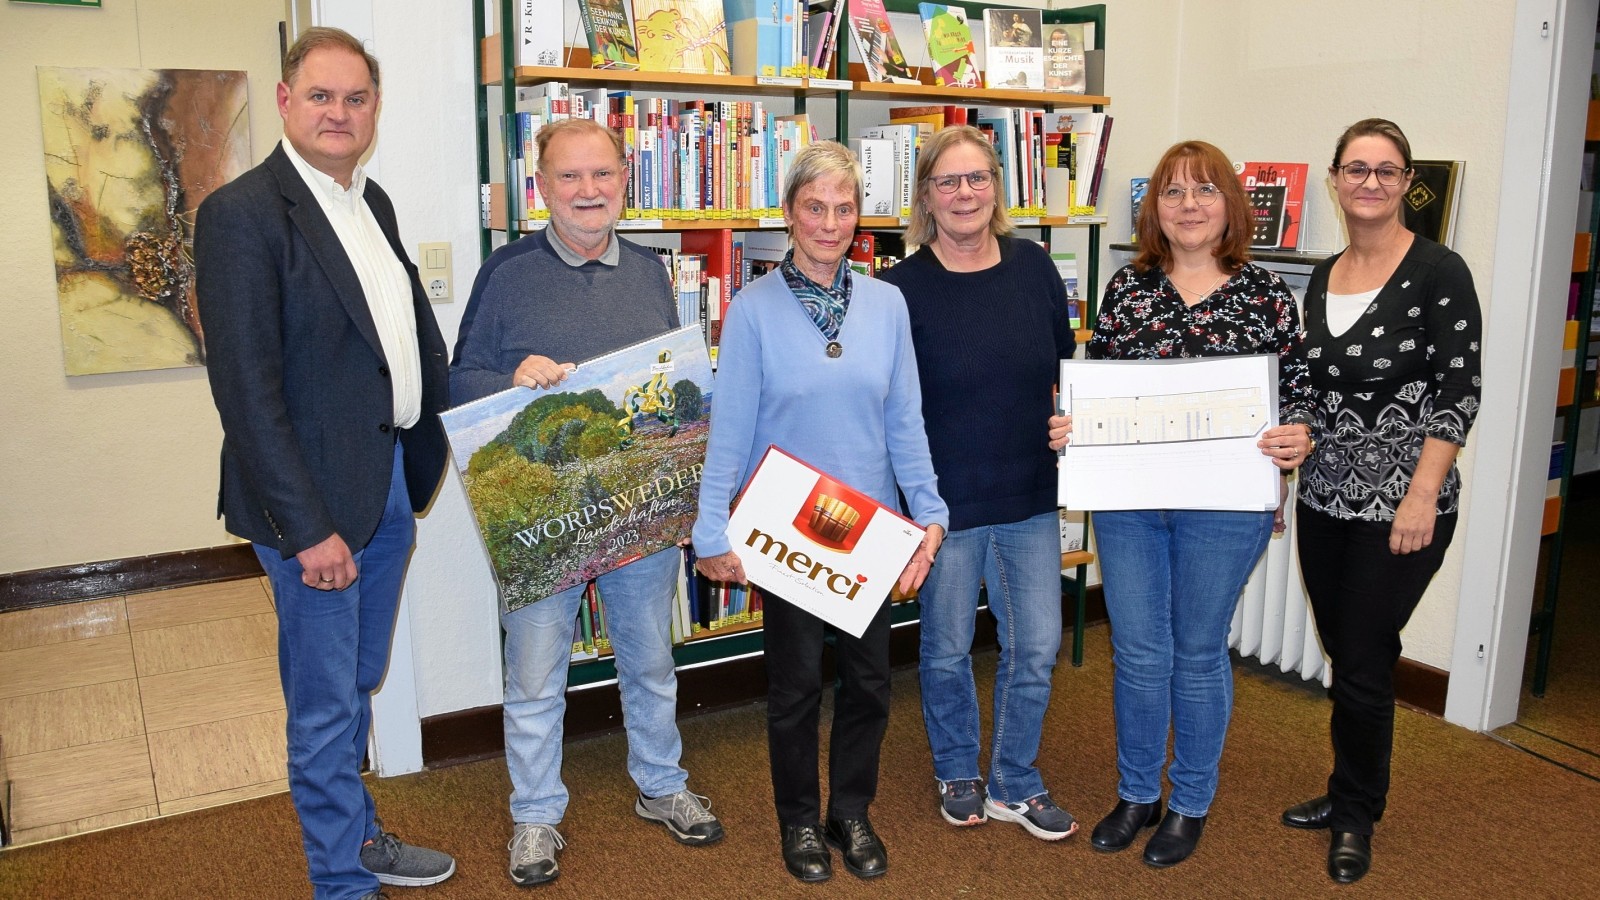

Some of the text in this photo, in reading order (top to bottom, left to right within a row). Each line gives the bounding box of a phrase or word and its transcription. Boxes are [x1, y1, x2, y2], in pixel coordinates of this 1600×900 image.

[591, 8, 624, 20] SEEMANNS
[593, 16, 619, 27] LEXIKON
[525, 26, 532, 34] R
[595, 25, 628, 37] DER KUNST
[1005, 55, 1034, 63] Musik
[1257, 166, 1277, 184] info
[514, 462, 704, 548] WORPSWEDER
[572, 499, 677, 546] Landschaften
[608, 529, 640, 551] 2023
[745, 528, 867, 601] merci
